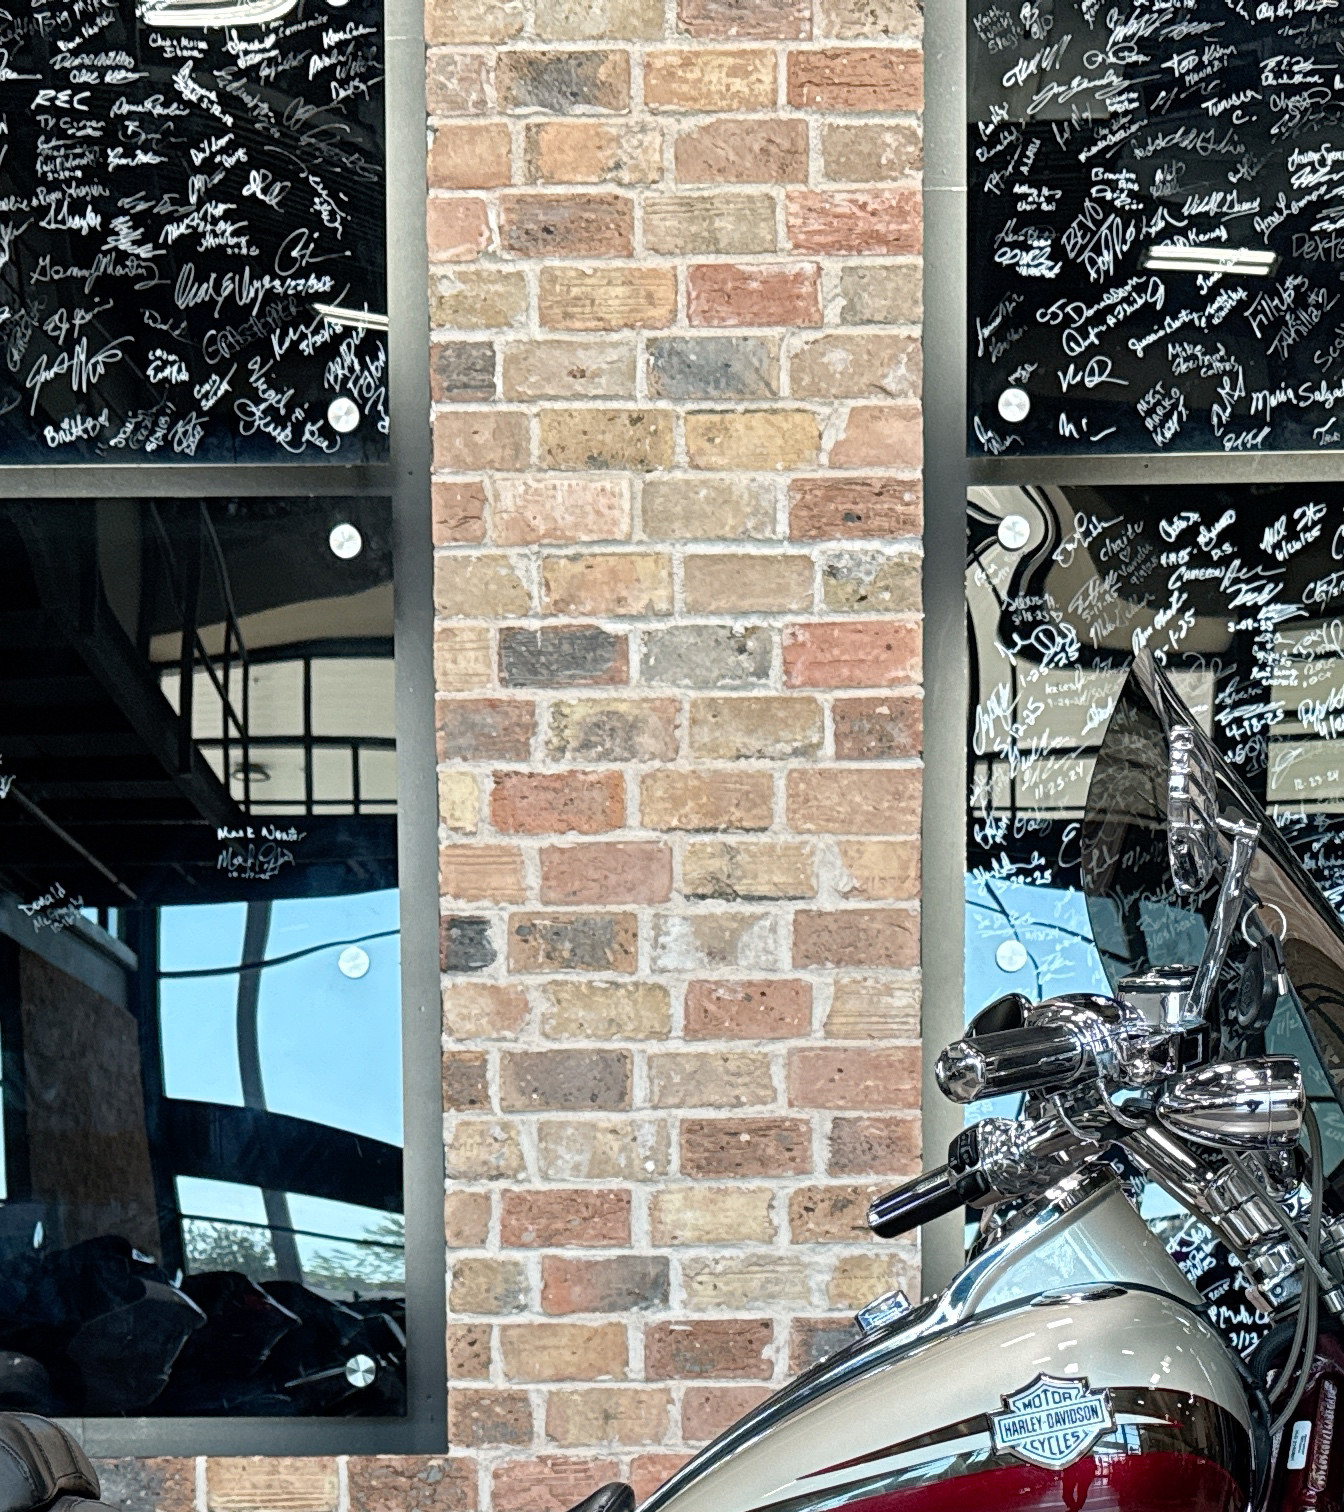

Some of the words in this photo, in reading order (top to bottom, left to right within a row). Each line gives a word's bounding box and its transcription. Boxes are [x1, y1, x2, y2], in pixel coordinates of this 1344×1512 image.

[1022, 1388, 1073, 1411] MOTOR
[1003, 1404, 1099, 1439] HARLEY-DAVIDSON
[1029, 1431, 1081, 1457] CYCLES
